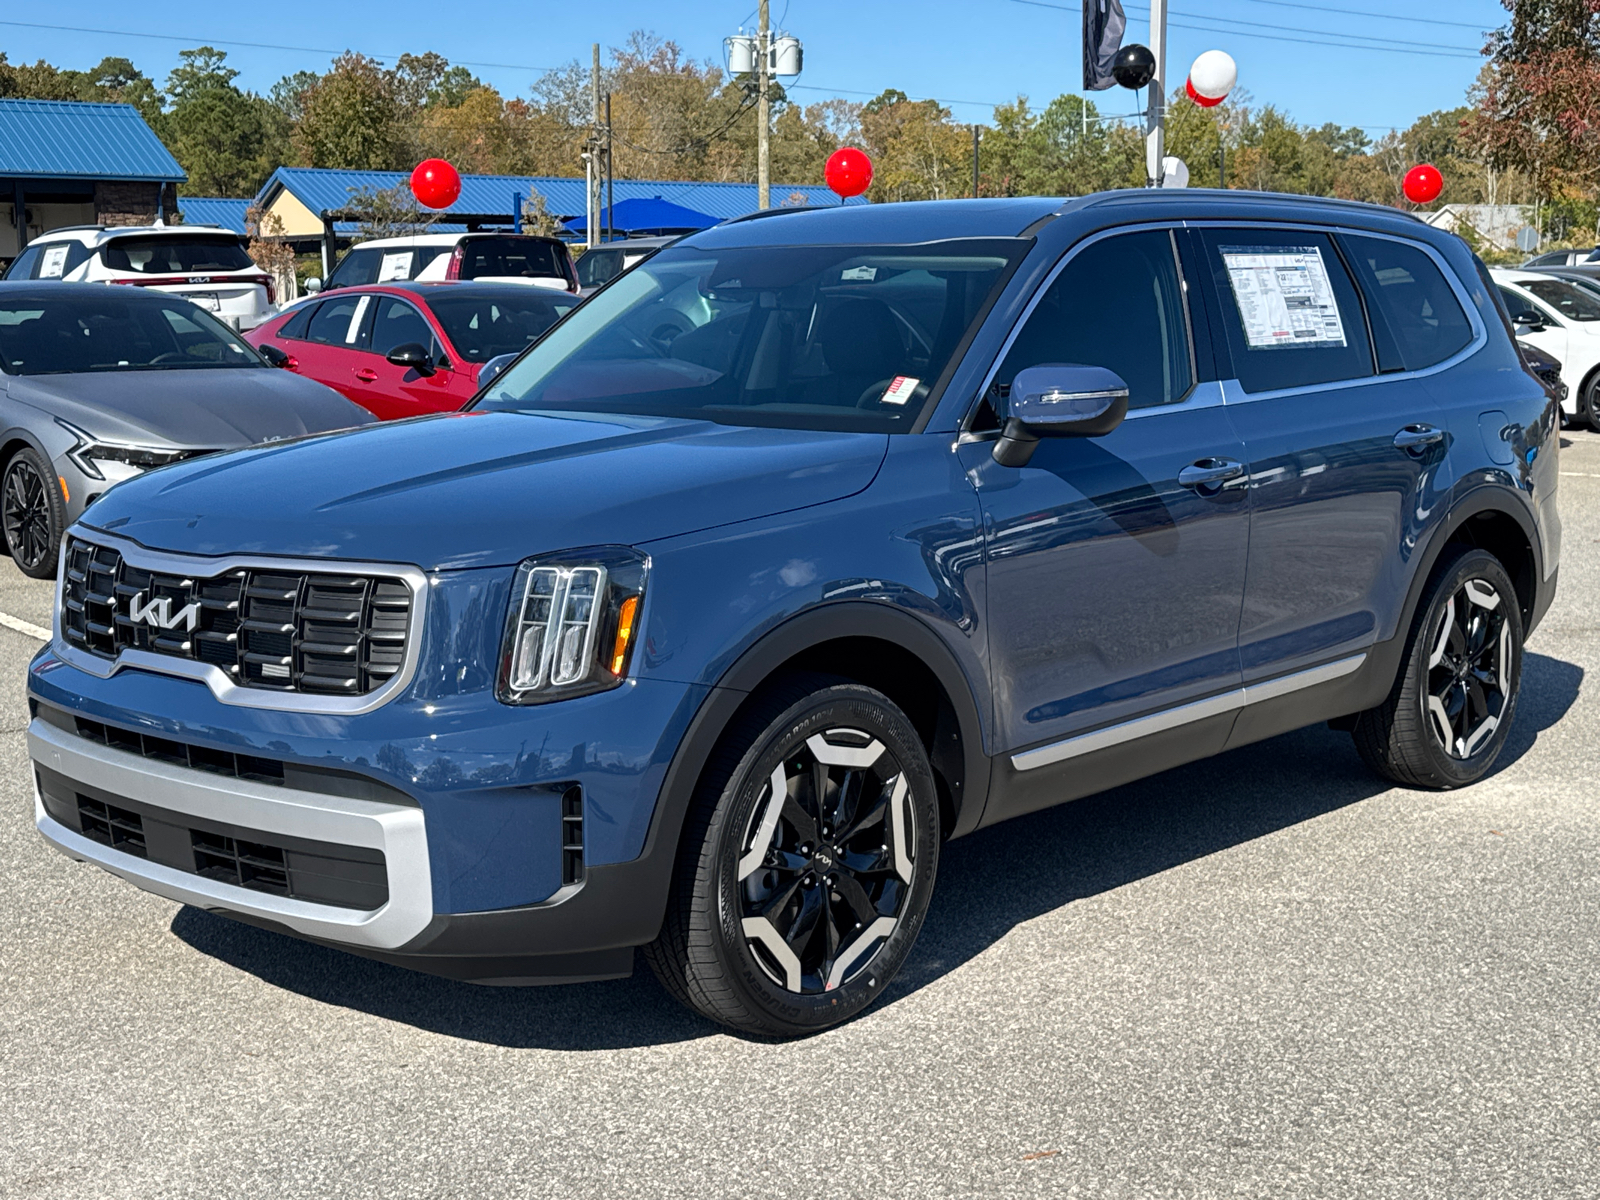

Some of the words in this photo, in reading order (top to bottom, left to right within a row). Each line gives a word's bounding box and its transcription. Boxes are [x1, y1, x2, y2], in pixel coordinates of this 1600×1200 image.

[129, 591, 201, 633] KIA
[925, 803, 937, 882] KUMHO
[743, 971, 802, 1018] CRUGEN
